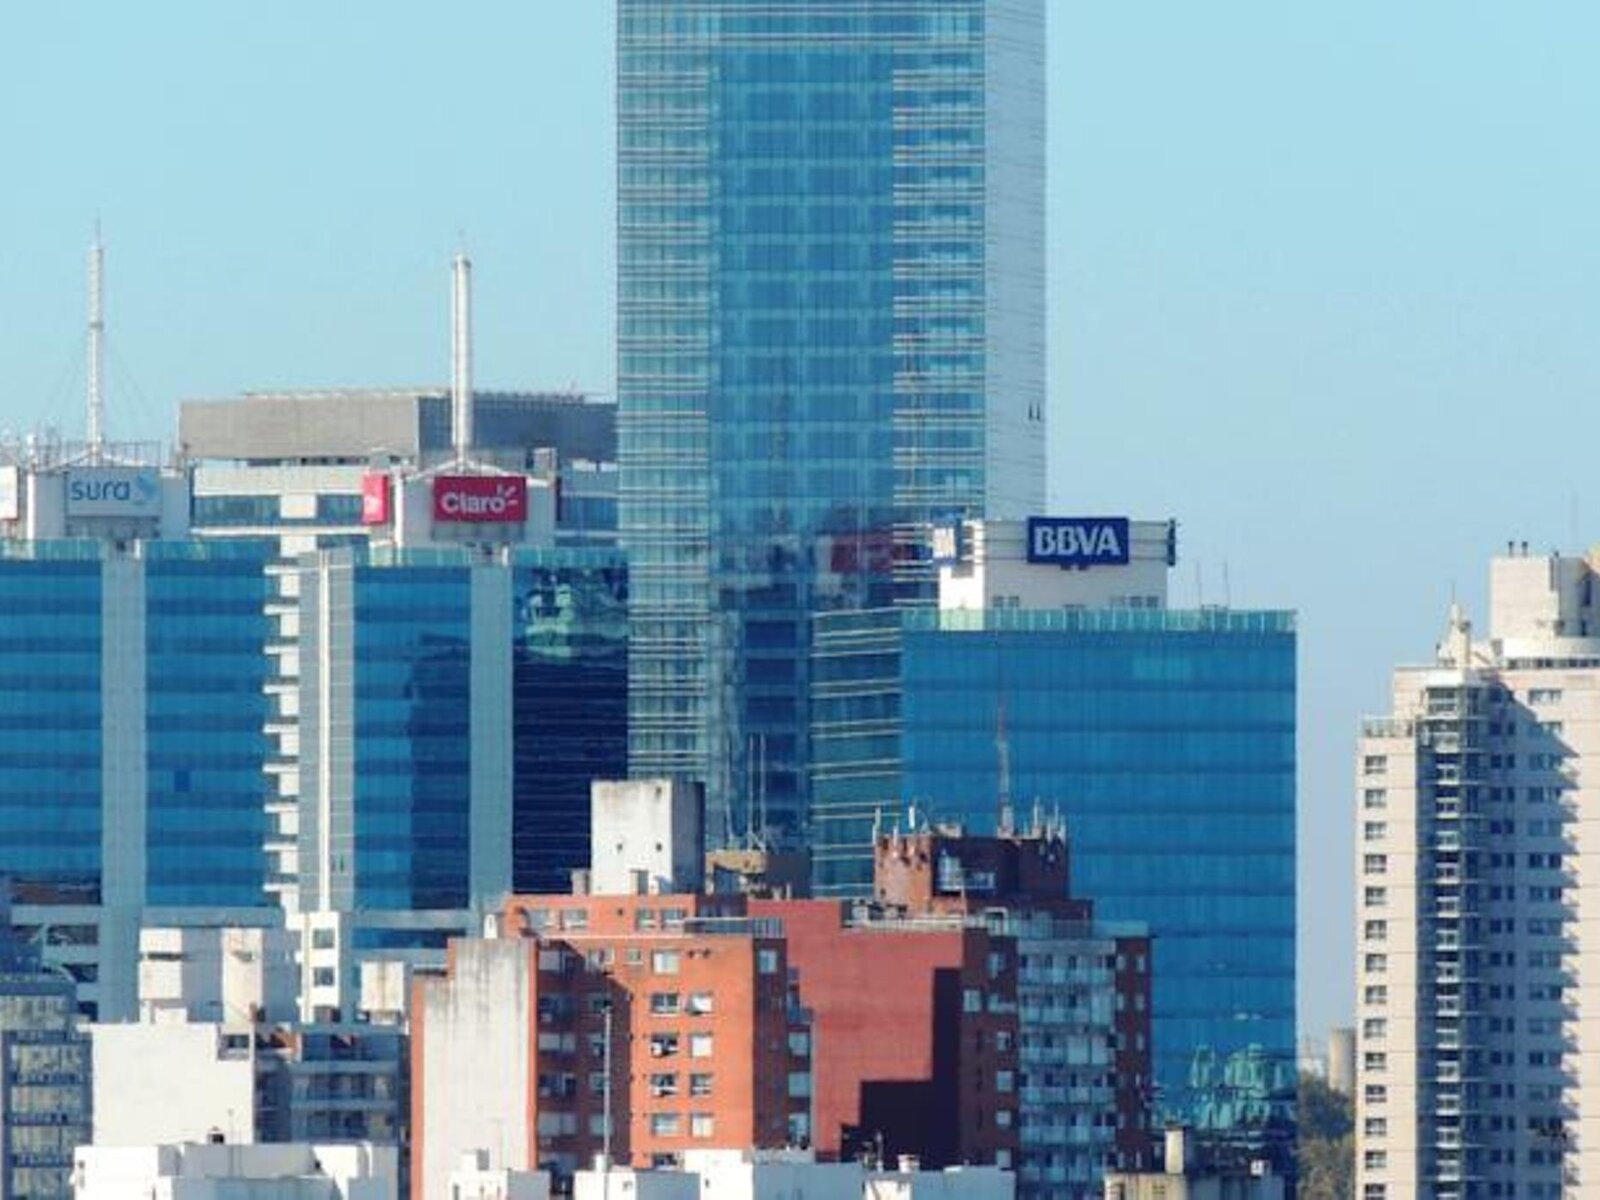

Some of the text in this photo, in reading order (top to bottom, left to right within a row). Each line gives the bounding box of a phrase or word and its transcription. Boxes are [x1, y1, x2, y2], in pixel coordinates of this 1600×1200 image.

[71, 480, 130, 501] sura
[440, 491, 507, 514] Claro
[1033, 525, 1122, 556] BBVA
